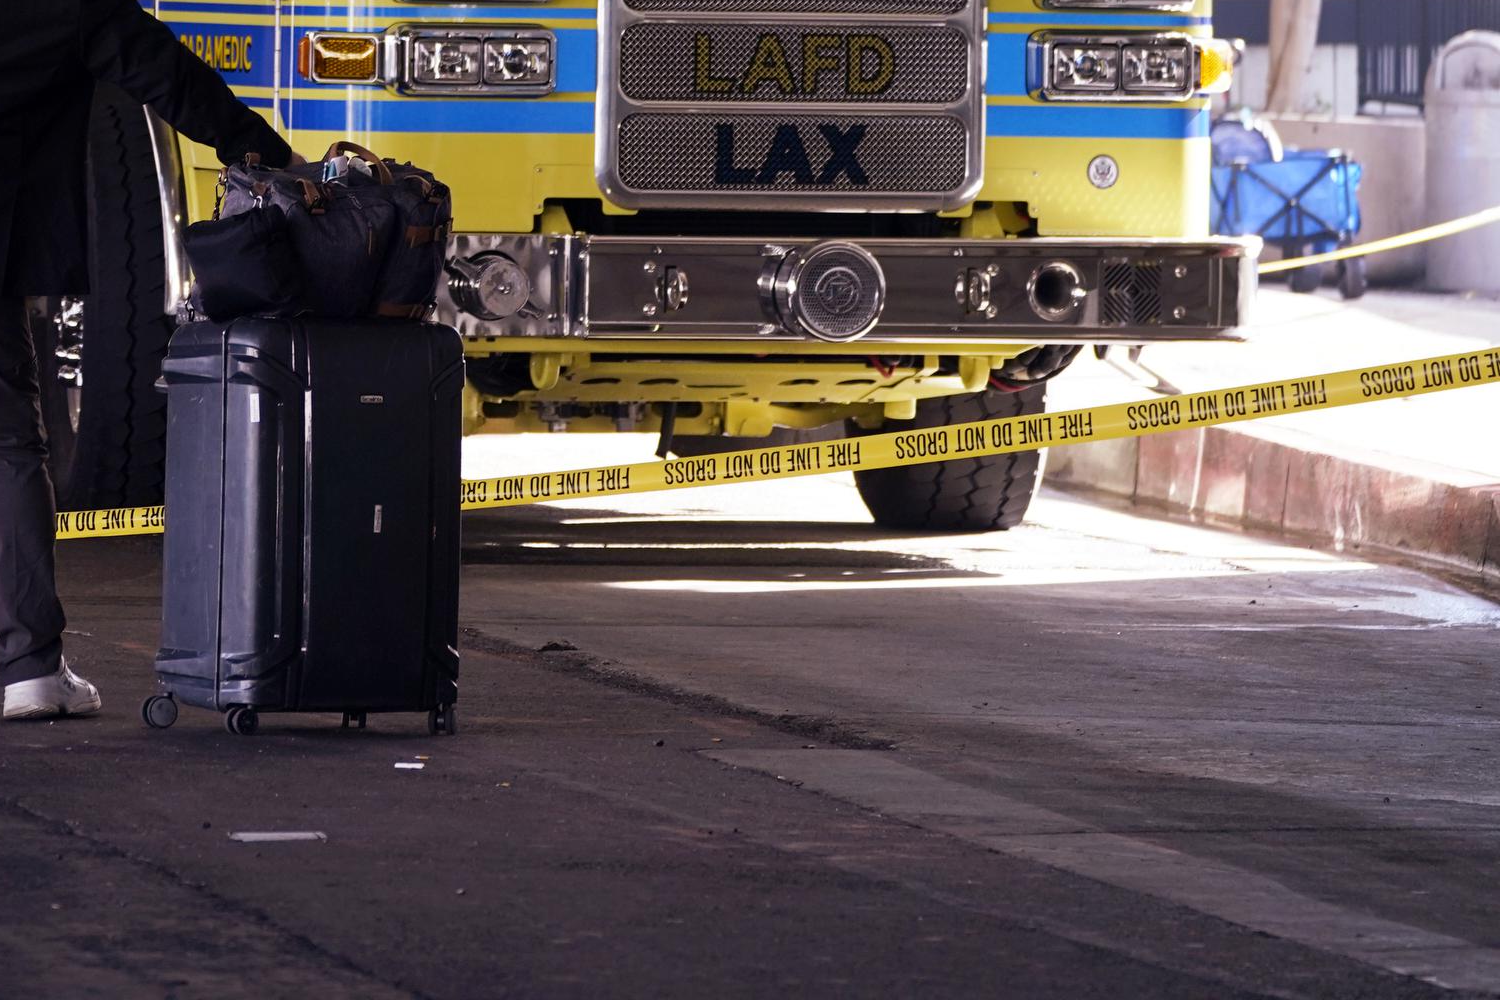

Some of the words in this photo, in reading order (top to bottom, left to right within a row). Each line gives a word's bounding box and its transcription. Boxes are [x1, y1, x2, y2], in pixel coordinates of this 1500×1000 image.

[695, 33, 896, 96] LAFD
[713, 124, 870, 186] LAX
[1360, 365, 1415, 397] CROSS
[1422, 359, 1454, 388] NOT
[1458, 355, 1482, 382] DO
[1224, 390, 1247, 418] DO
[1251, 385, 1287, 414] LINE
[1292, 378, 1327, 408] FIRE
[1127, 400, 1181, 430] CROSS
[1187, 395, 1219, 423] NOT
[991, 422, 1013, 448] DO
[1018, 417, 1052, 443] LINE
[1059, 412, 1093, 438] FIRE
[895, 431, 948, 459] CROSS
[954, 425, 986, 453] NOT
[723, 454, 753, 479] NOT
[760, 451, 781, 476] DO
[787, 447, 820, 472] LINE
[827, 441, 861, 468] FIRE
[556, 472, 590, 496] LINE
[596, 467, 631, 491] FIRE
[664, 458, 717, 485] CROSS
[461, 481, 487, 504] CRO
[493, 478, 524, 501] NOT
[530, 476, 551, 498] DO
[76, 511, 97, 531] DO
[102, 508, 135, 530] LINE
[141, 506, 165, 528] IRE
